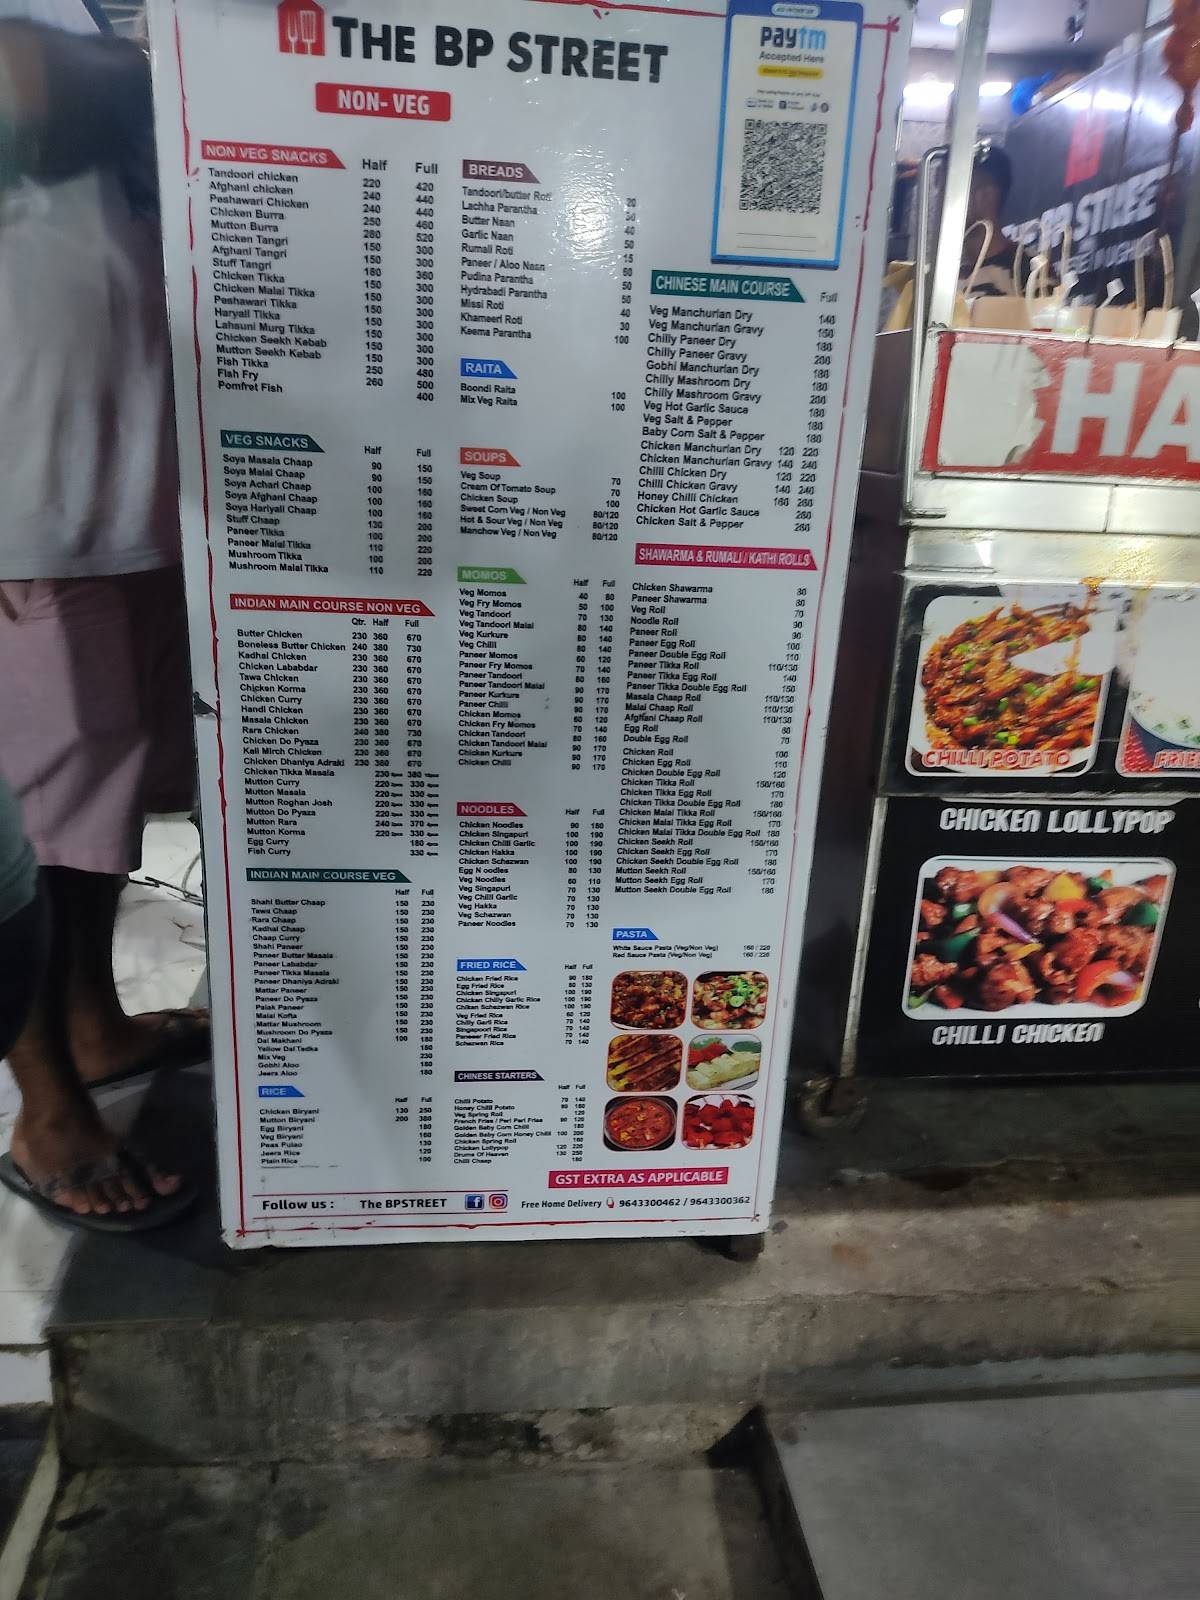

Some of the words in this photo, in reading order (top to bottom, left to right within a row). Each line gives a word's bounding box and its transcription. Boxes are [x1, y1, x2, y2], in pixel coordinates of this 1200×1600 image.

[760, 26, 826, 50] paytm
[332, 16, 415, 63] THE
[435, 25, 494, 68] BP
[506, 31, 669, 83] STREET
[338, 89, 388, 111] NON-
[393, 93, 430, 115] VEG
[206, 144, 236, 158] NON
[239, 147, 268, 160] VEG
[271, 149, 327, 164] SNACKS
[362, 158, 388, 171] Half
[415, 162, 438, 175] Full
[469, 164, 523, 178] BREADS
[208, 167, 254, 180] Tandoori
[257, 171, 299, 183] chicken
[362, 178, 381, 189] 220
[415, 182, 434, 192] 420
[208, 181, 250, 193] Afghani
[252, 184, 293, 195] chicken
[362, 191, 381, 201] 240
[415, 195, 434, 205] 440
[209, 193, 264, 206] Peshawari
[266, 197, 309, 209] Chicken
[362, 203, 381, 214] 240
[415, 207, 434, 217] 440
[210, 206, 252, 218] Chicken
[255, 209, 285, 220] Burra
[362, 216, 381, 227] 250
[461, 214, 491, 226] Butter
[492, 216, 515, 228] Naan
[210, 219, 247, 230] Mutton
[249, 221, 279, 233] Burra
[416, 232, 434, 243] 520
[656, 275, 707, 292] CHINESE
[709, 278, 739, 293] MAIN
[741, 280, 790, 296] COURSE
[649, 304, 669, 318] Veg
[671, 306, 732, 319] Manchurian
[734, 309, 753, 323] Dry
[460, 326, 491, 336] Keema
[493, 327, 532, 339] Parantha
[614, 335, 629, 345] 100
[647, 346, 677, 360] Chilly
[679, 348, 715, 359] Paneer
[717, 350, 748, 363] Gravy
[466, 363, 502, 374] RAITA
[460, 383, 492, 393] Boondi
[494, 384, 516, 394] Raita
[611, 391, 626, 400] 100
[225, 434, 252, 445] VEG
[256, 435, 308, 448] SNACKS
[364, 445, 382, 455] Half
[416, 448, 431, 457] Full
[464, 451, 507, 463] SOUPS
[222, 454, 246, 465] Soya
[248, 455, 281, 465] Masala
[283, 457, 313, 468] Chaap
[371, 461, 382, 471] 90
[417, 464, 433, 473] 150
[460, 470, 476, 481] Veg
[478, 471, 501, 482] Soup
[611, 477, 621, 486] 70
[636, 503, 676, 514] Chicken
[679, 505, 696, 515] Hot
[698, 505, 728, 516] Garlic
[730, 507, 760, 517] Sauce
[639, 548, 695, 562] SHAWARMA
[696, 550, 703, 562] &
[749, 552, 777, 564] KATHI
[778, 553, 810, 566] ROLLS
[462, 570, 506, 580] MOMOS
[573, 579, 589, 587] Half
[602, 579, 616, 588] Full
[632, 582, 667, 592] Chicken
[669, 583, 713, 593] Shawarma
[459, 588, 475, 598] Veg
[477, 588, 507, 597] Momos
[235, 598, 276, 608] INDIAN
[279, 599, 309, 609] MAIN
[313, 600, 364, 611] COURSE
[367, 602, 393, 612] NON
[396, 604, 420, 613] VEG
[631, 605, 647, 616] Veg
[648, 605, 666, 614] Roll
[351, 617, 367, 626] Qtr.
[372, 618, 389, 626] Half
[405, 619, 419, 628] Full
[237, 628, 265, 638] Butter
[266, 629, 303, 639] Chicken
[352, 632, 368, 640] 230
[406, 633, 422, 642] 670
[237, 640, 279, 649] Boneless
[281, 641, 309, 650] Butter
[310, 642, 346, 651] Chicken
[352, 642, 368, 651] 240
[406, 644, 422, 653] 730
[921, 749, 988, 768] CHILLI
[988, 749, 1072, 768] POTATO
[461, 805, 514, 814] NOODLES
[592, 808, 605, 816] Full
[492, 821, 524, 829] Noodles
[939, 808, 1041, 832] CHICKEN
[1047, 809, 1175, 834] LOLLYPOP
[251, 870, 288, 879] INDIAN
[292, 871, 319, 879] MAIN
[323, 872, 370, 880] COURSE
[372, 872, 396, 880] VEG
[274, 898, 300, 906] Butter
[300, 899, 326, 907] Chaap
[460, 961, 490, 969] FRIED
[932, 1025, 1006, 1045] CHILLI
[1011, 1022, 1105, 1044] CHICKEN
[458, 1072, 493, 1080] CHINESE
[292, 1108, 320, 1116] Biryani
[555, 1174, 581, 1184] GST
[584, 1174, 625, 1184] EXTRA
[627, 1173, 645, 1183] AS
[648, 1171, 723, 1183] APPLICABLE
[262, 1199, 308, 1210] Follow
[311, 1201, 327, 1209] us
[359, 1199, 382, 1209] The
[385, 1198, 448, 1208] BPSTREET
[541, 1200, 566, 1208] Home
[567, 1199, 602, 1209] Delivery
[619, 1198, 681, 1207] 9643300462
[690, 1196, 750, 1206] 9643300362
